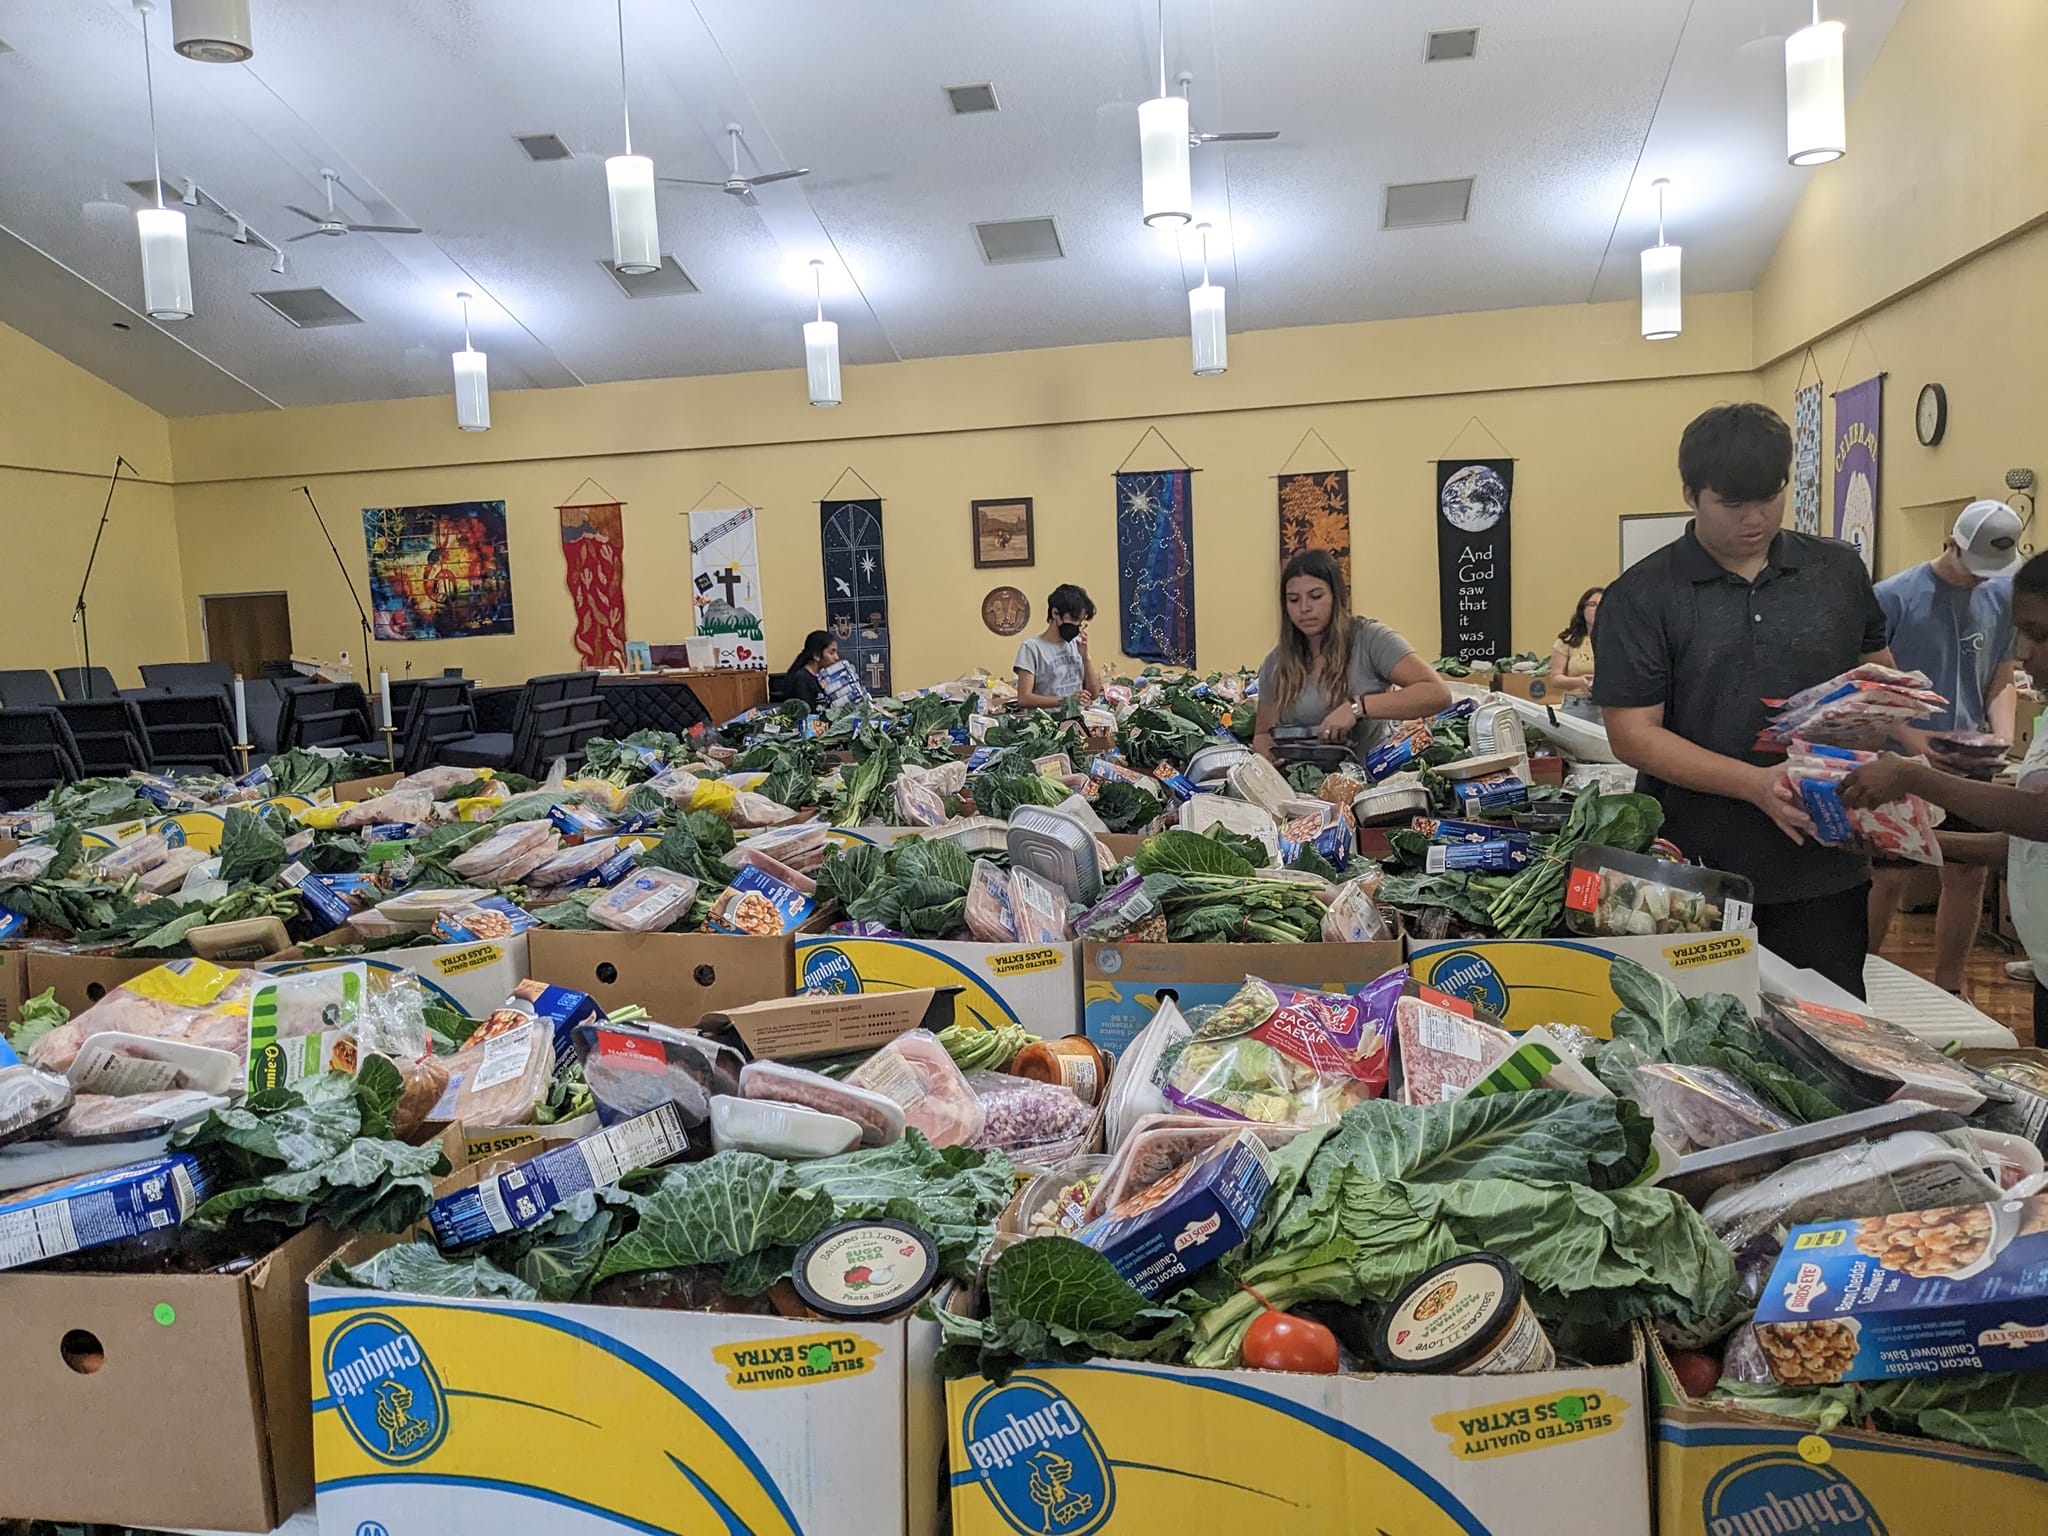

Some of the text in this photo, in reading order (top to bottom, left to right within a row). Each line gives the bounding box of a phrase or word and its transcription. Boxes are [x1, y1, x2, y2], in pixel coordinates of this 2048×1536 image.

[1458, 544, 1493, 563] And
[1458, 563, 1494, 583] God
[1458, 586, 1485, 596] saw
[1459, 595, 1488, 611] that
[1459, 614, 1469, 626] it
[1459, 631, 1485, 641] was
[1458, 640, 1495, 661] good
[441, 946, 492, 966] CLASS EXTRA
[995, 950, 1053, 965] CLASS EXTRA
[1673, 937, 1741, 958] CLASS EXTRA
[1675, 948, 1746, 967] SELECTED QUALITY
[443, 961, 468, 974] QUALITY
[805, 954, 851, 988] Chiquita
[996, 958, 1057, 974] SELECTED QUALITY
[1279, 1011, 1321, 1031] BACO
[1273, 1020, 1327, 1044] CAESAR
[468, 1142, 491, 1156] EXT
[1178, 1219, 1217, 1246] BIRDS EYE
[820, 1235, 859, 1261] Sauces
[877, 1232, 903, 1246] Love
[846, 1246, 883, 1259] SUGO
[847, 1254, 884, 1264] ROSA
[1134, 1252, 1177, 1283] Cauliflower
[1157, 1263, 1186, 1283] Bacon
[842, 1283, 904, 1301] Pasta Sauces
[1791, 1266, 1817, 1308] BIRDS EYE
[1834, 1260, 1867, 1312] Bacon Cheddar
[1858, 1268, 1886, 1304] Cauliflower
[1884, 1277, 1901, 1293] Bake
[1421, 1292, 1481, 1339] MARINARA
[1461, 1291, 1495, 1333] Sauces
[1415, 1339, 1445, 1352] Love
[1985, 1328, 2046, 1343] BIRDS EYE
[734, 1338, 856, 1367] CLS EXTRA
[1880, 1343, 1976, 1361] Cauliflower Bake
[328, 1333, 421, 1398] Chiquita
[737, 1365, 794, 1384] QUALITY
[1885, 1356, 1983, 1373] Bacon Cheddar
[1459, 1393, 1602, 1436] CSS EXTRA
[968, 1399, 1081, 1469] Chiquita
[1464, 1414, 1612, 1454] SELECTED QUALITY
[1709, 1483, 1865, 1536] Chiquita
